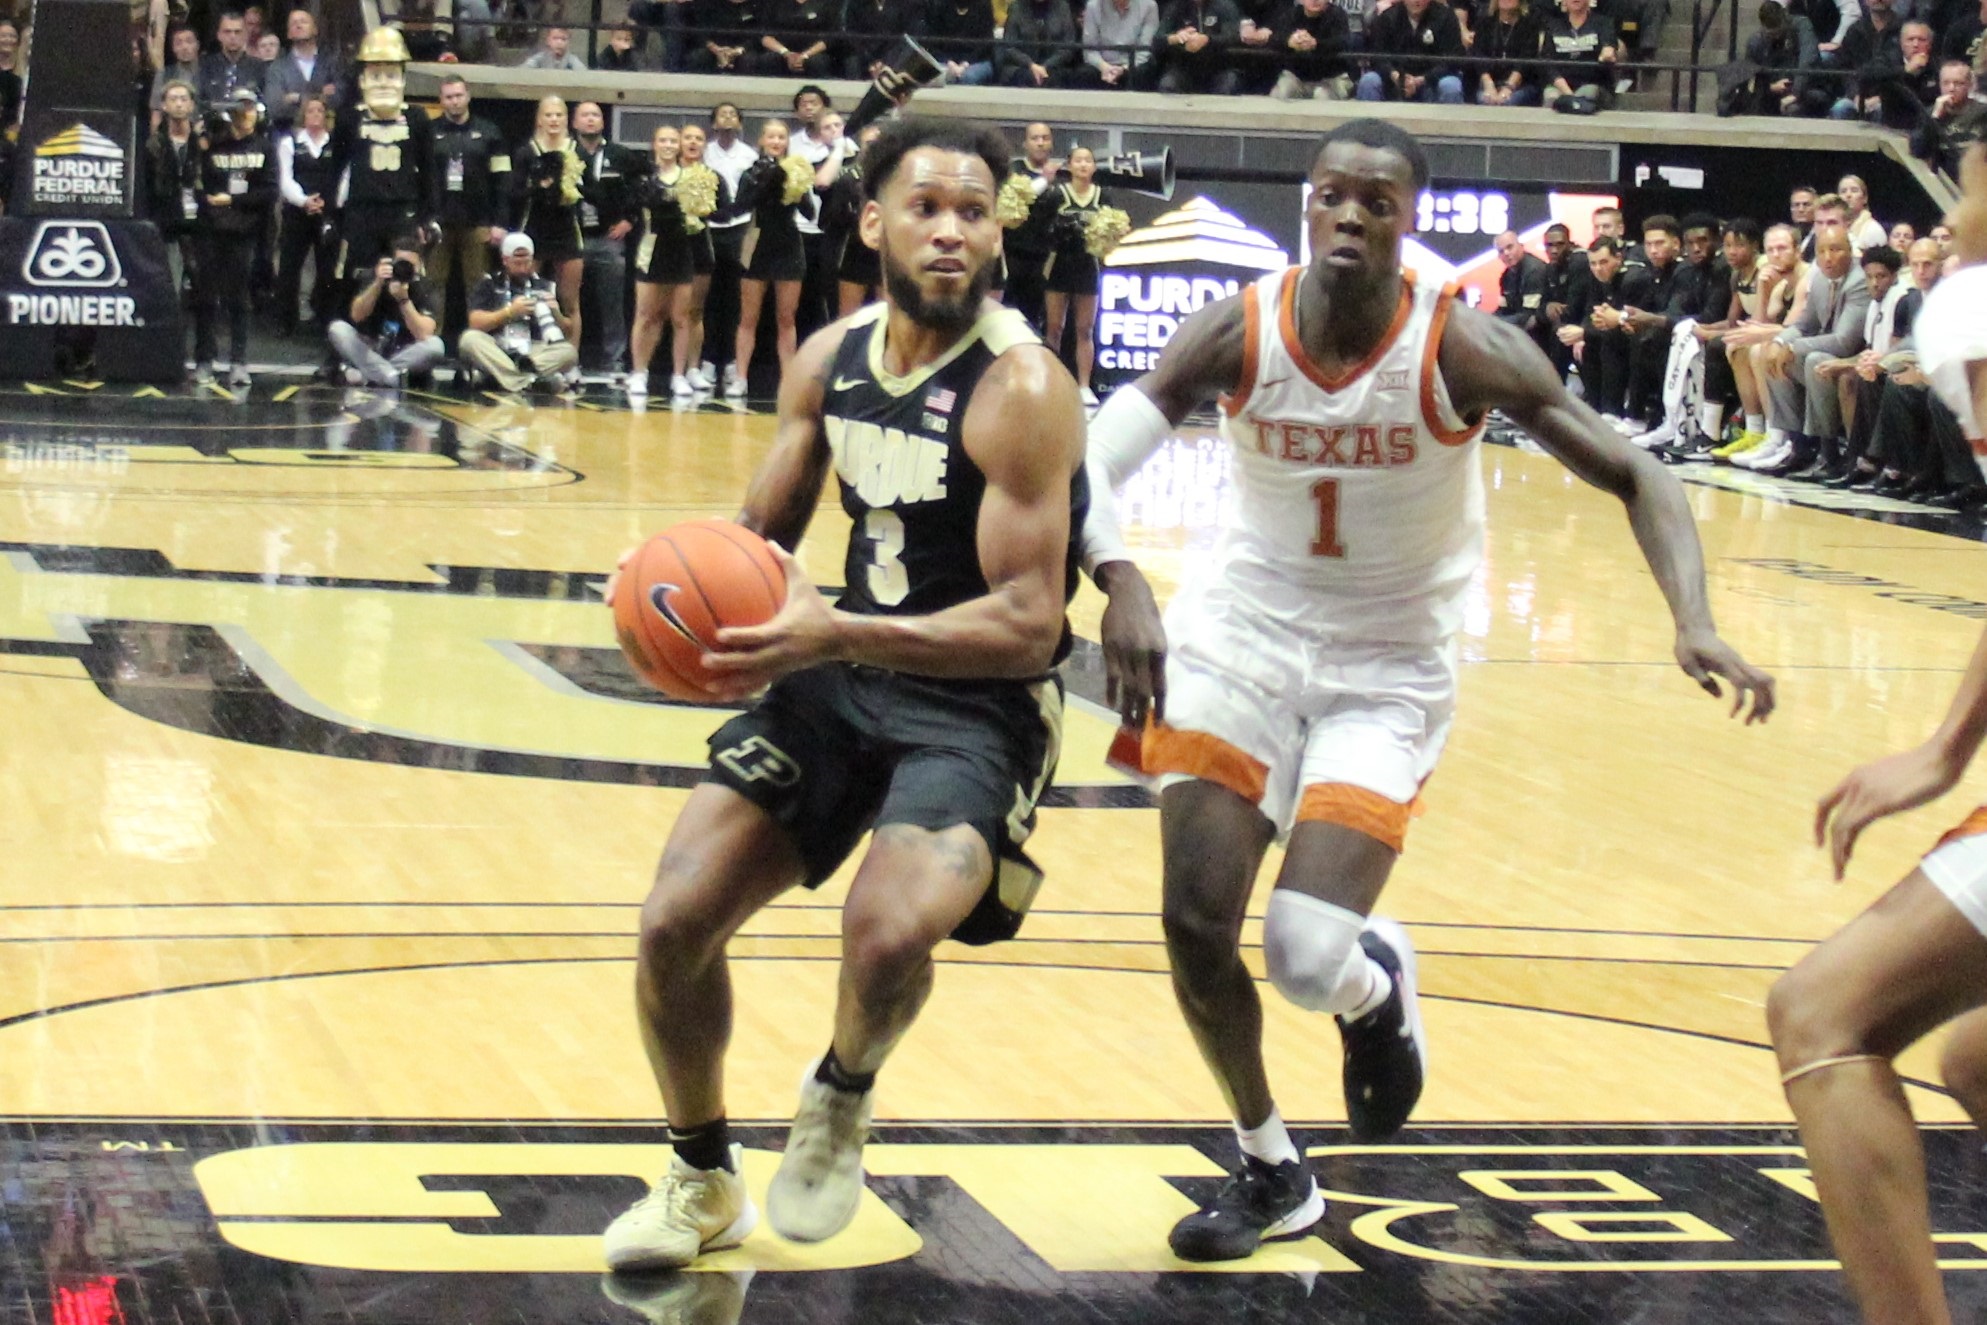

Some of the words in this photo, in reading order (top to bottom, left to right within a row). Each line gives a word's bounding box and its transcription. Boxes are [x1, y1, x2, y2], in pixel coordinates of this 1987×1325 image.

[34, 159, 124, 178] PURDUE
[34, 176, 123, 195] FEDERAL
[34, 193, 79, 204] CREDIT
[82, 194, 123, 205] UNION
[1250, 417, 1417, 467] TEXAS
[1311, 477, 1346, 558] 1
[865, 508, 911, 607] 3
